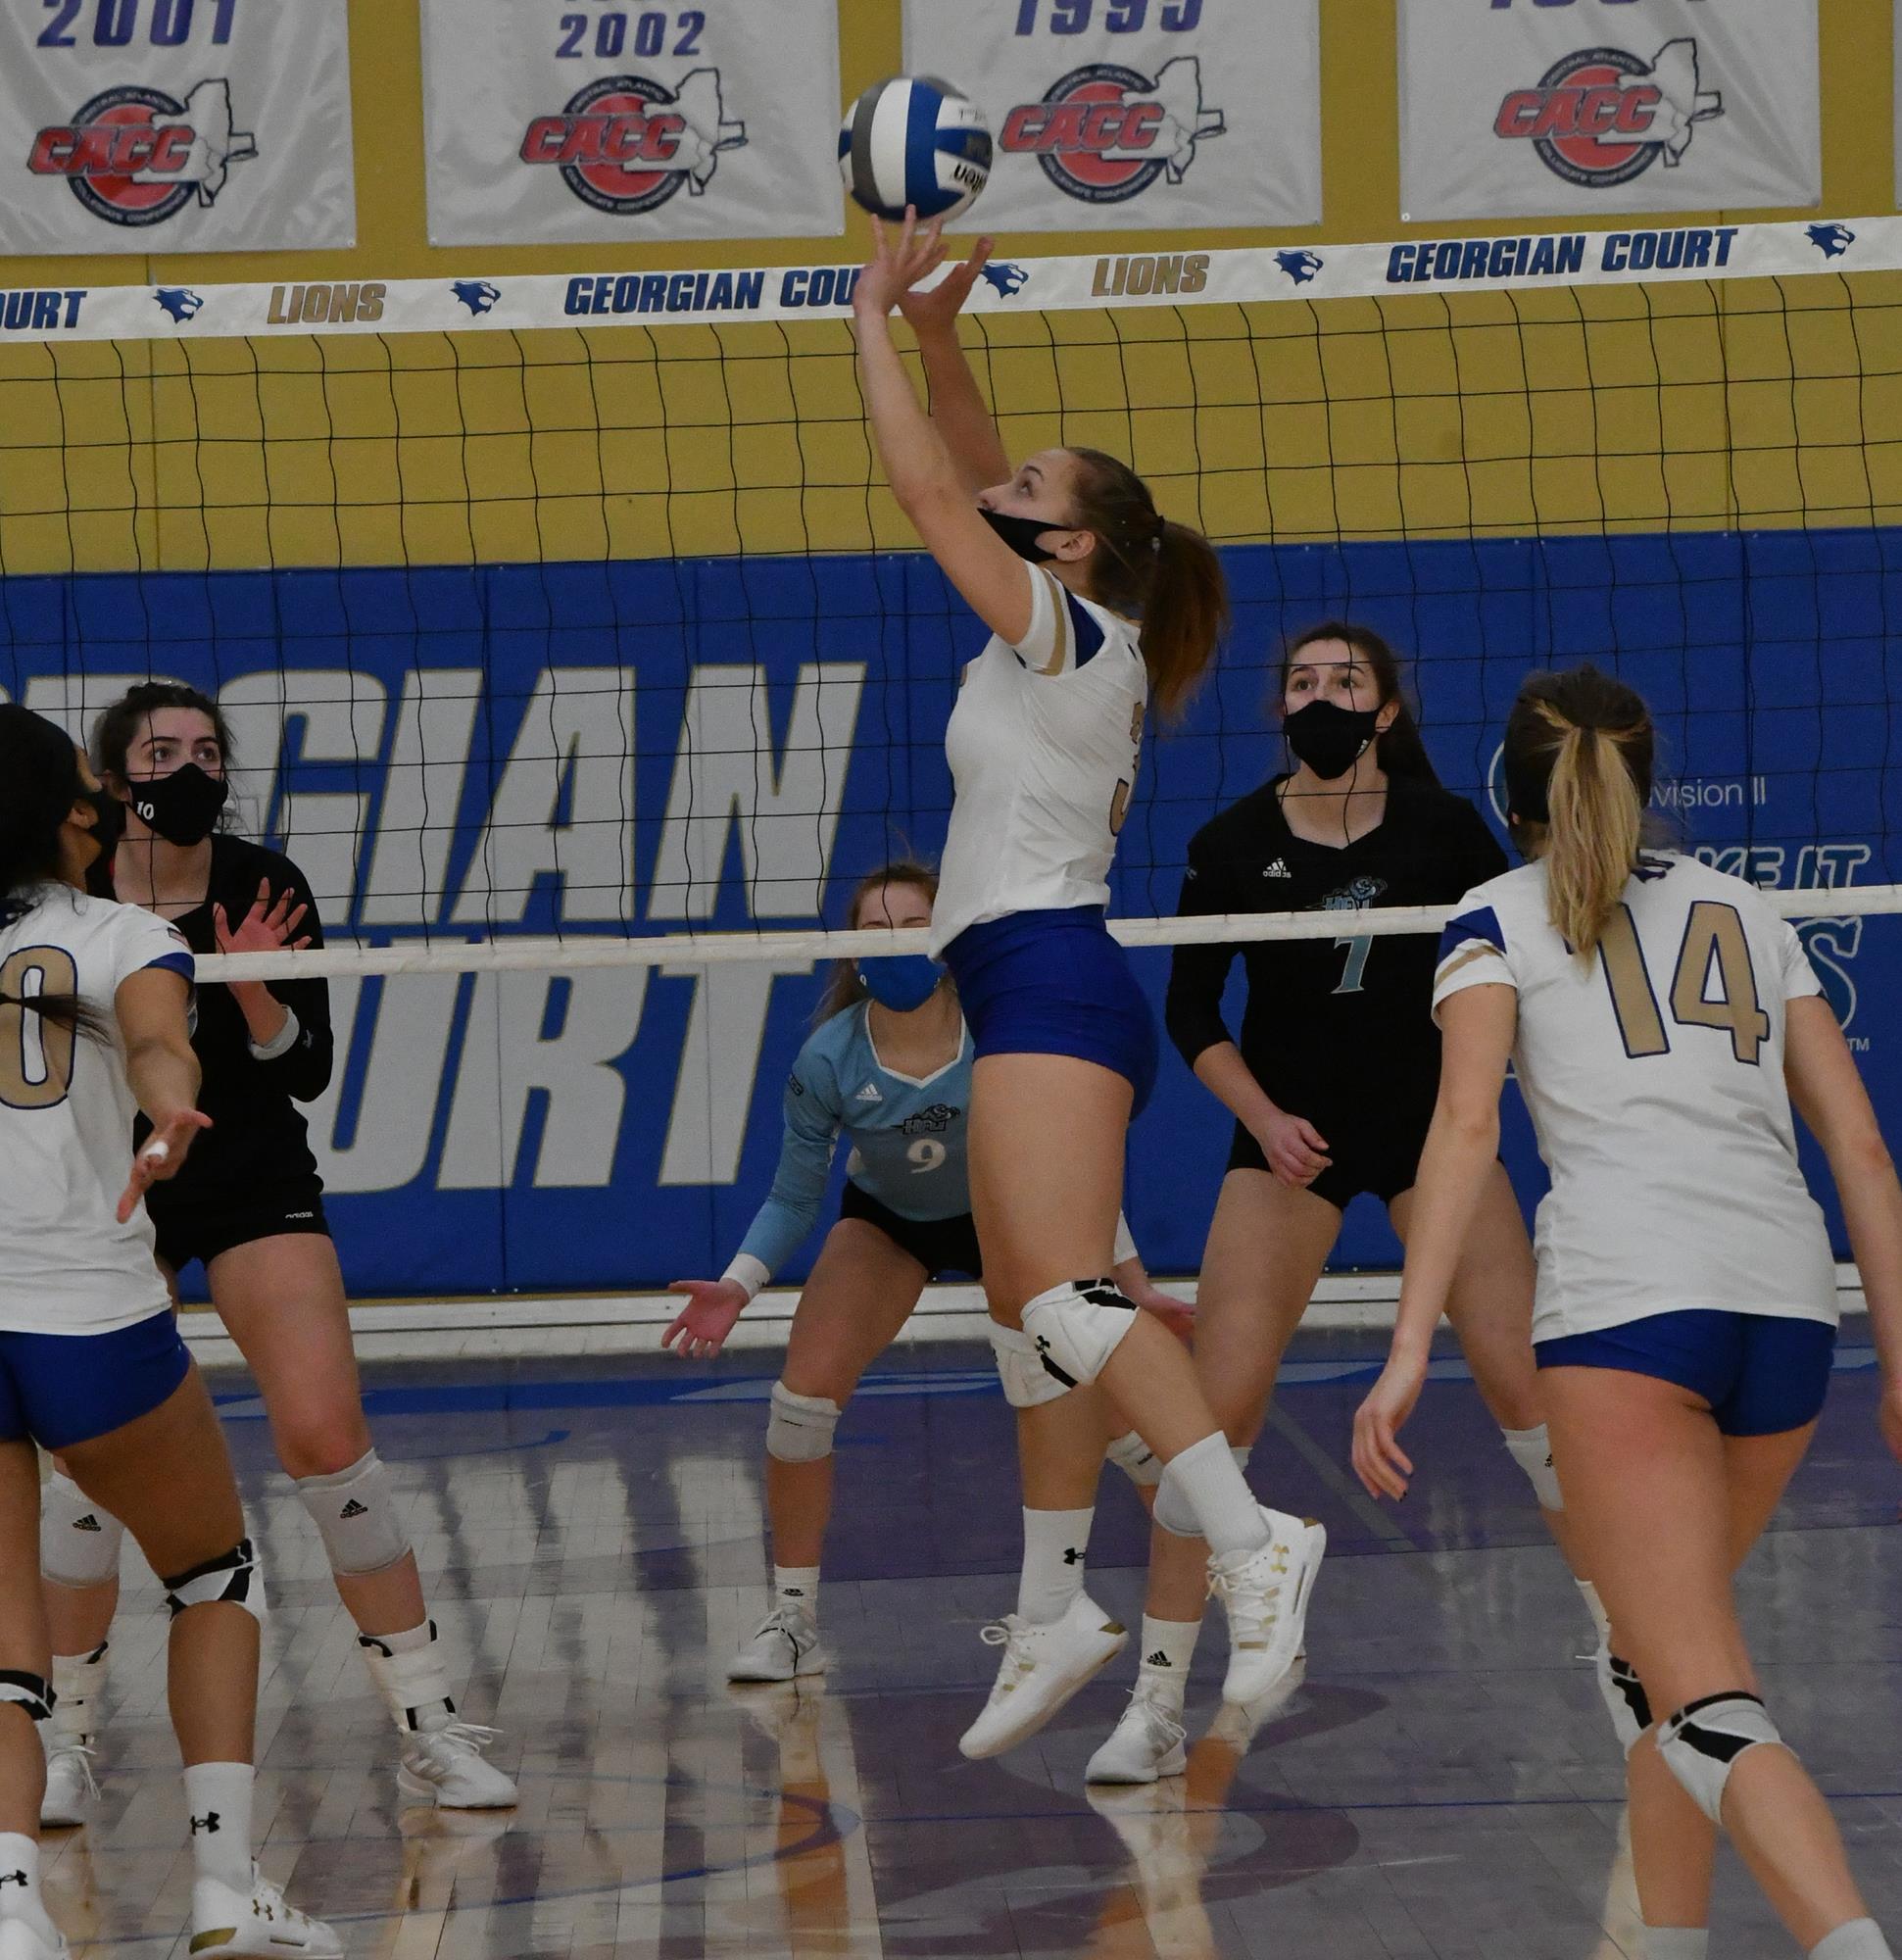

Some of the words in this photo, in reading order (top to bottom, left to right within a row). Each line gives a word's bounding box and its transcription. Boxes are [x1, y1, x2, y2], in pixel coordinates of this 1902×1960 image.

[36, 0, 235, 47] 2001
[556, 11, 706, 58] 2002
[998, 102, 1165, 153] CACC
[1493, 84, 1662, 138] CACC
[26, 124, 196, 174] CACC
[518, 114, 686, 164] CACC
[1092, 255, 1210, 296] LIONS
[1386, 235, 1587, 282] GEORGIAN
[1599, 228, 1739, 271] COURT
[0, 291, 87, 329] URT
[267, 284, 387, 324] LIONS
[564, 271, 765, 316] GEORGIAN
[780, 268, 862, 308] COU
[0, 662, 867, 927] GIAN
[137, 801, 154, 820] 10
[1650, 779, 1742, 808] vision
[1794, 844, 1872, 890] IT
[1331, 934, 1373, 994] 7
[1565, 900, 1770, 1065] 14
[288, 933, 817, 1195] URT
[906, 1138, 947, 1174] 9
